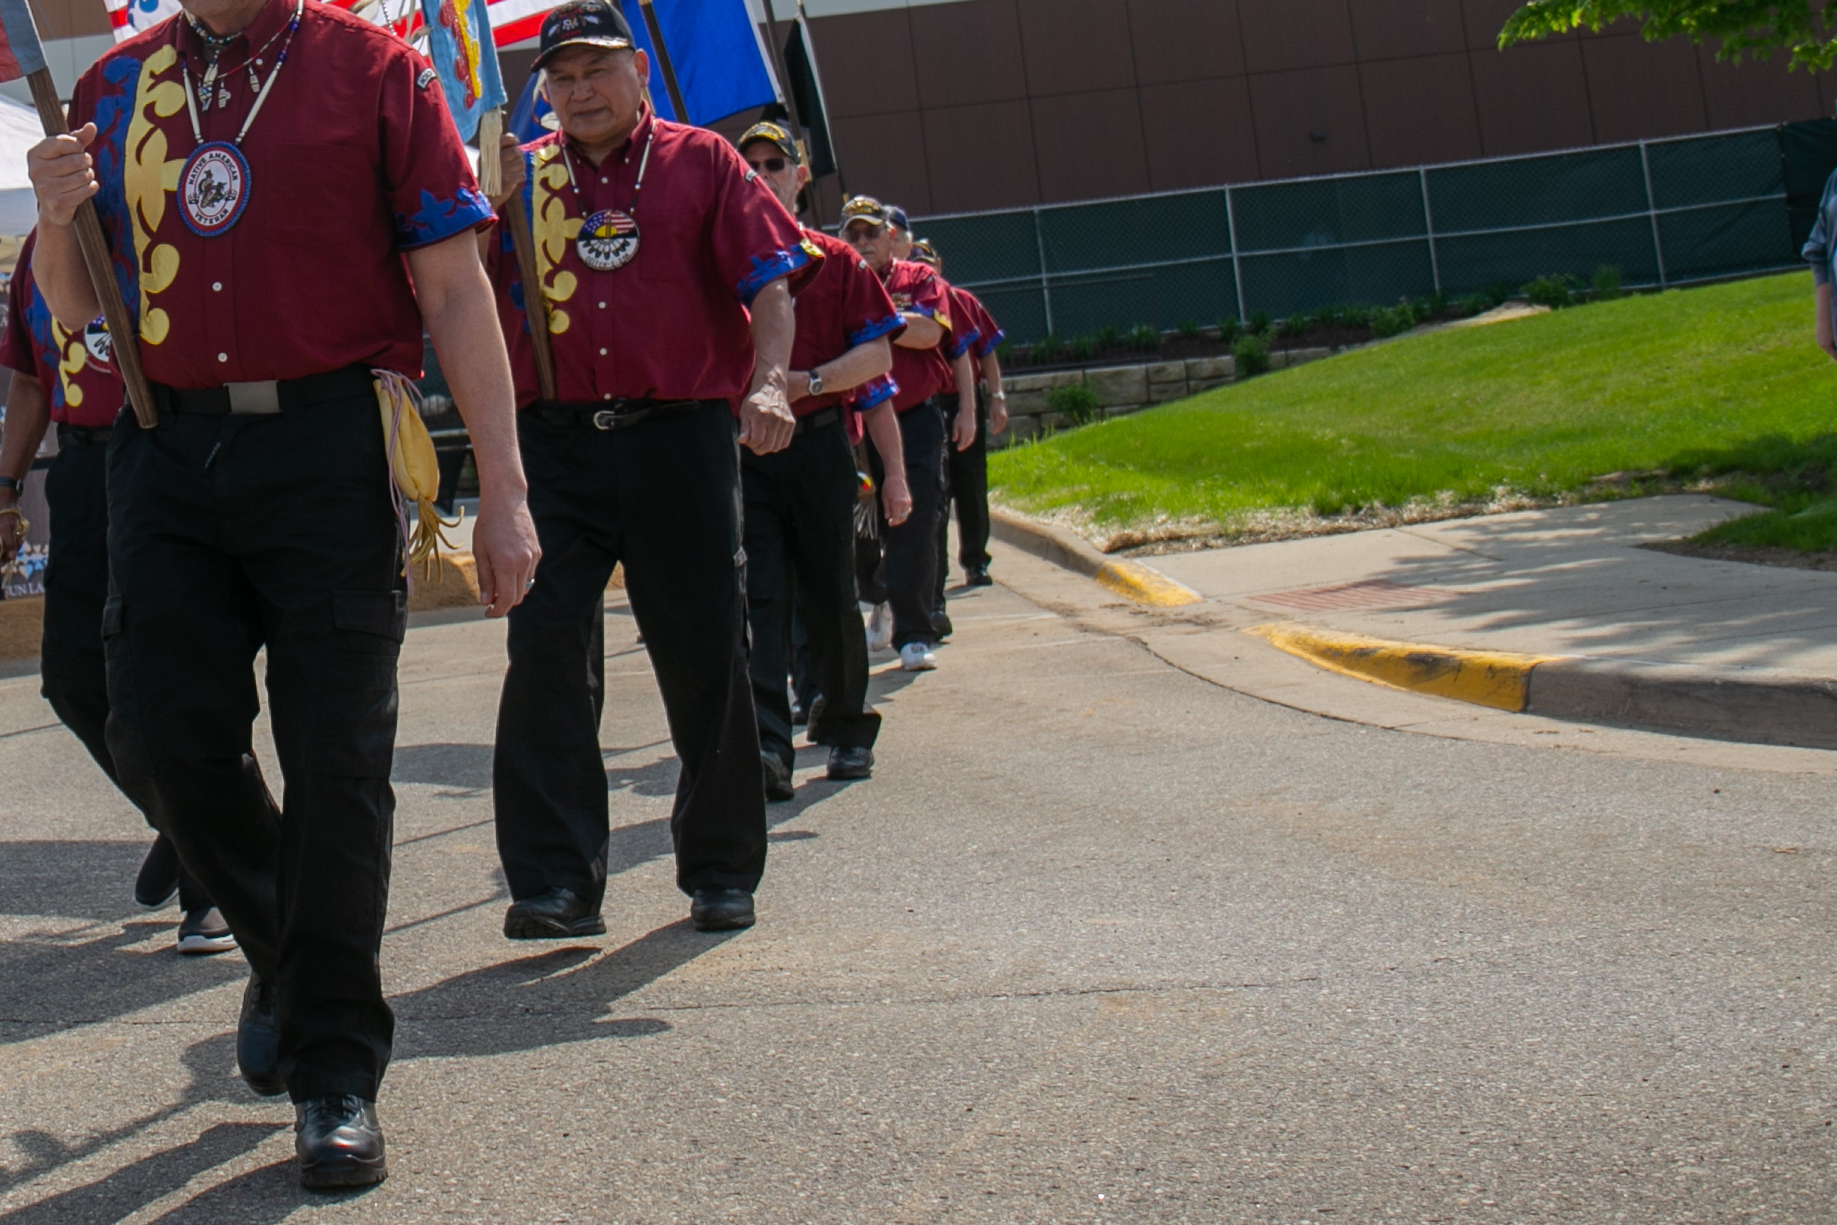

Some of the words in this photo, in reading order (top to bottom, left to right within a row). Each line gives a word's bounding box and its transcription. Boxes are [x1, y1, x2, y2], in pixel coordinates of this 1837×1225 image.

[188, 158, 207, 185] NATIVE
[208, 152, 238, 181] AMERICAN
[195, 209, 229, 224] VETERAN
[27, 582, 45, 594] LA
